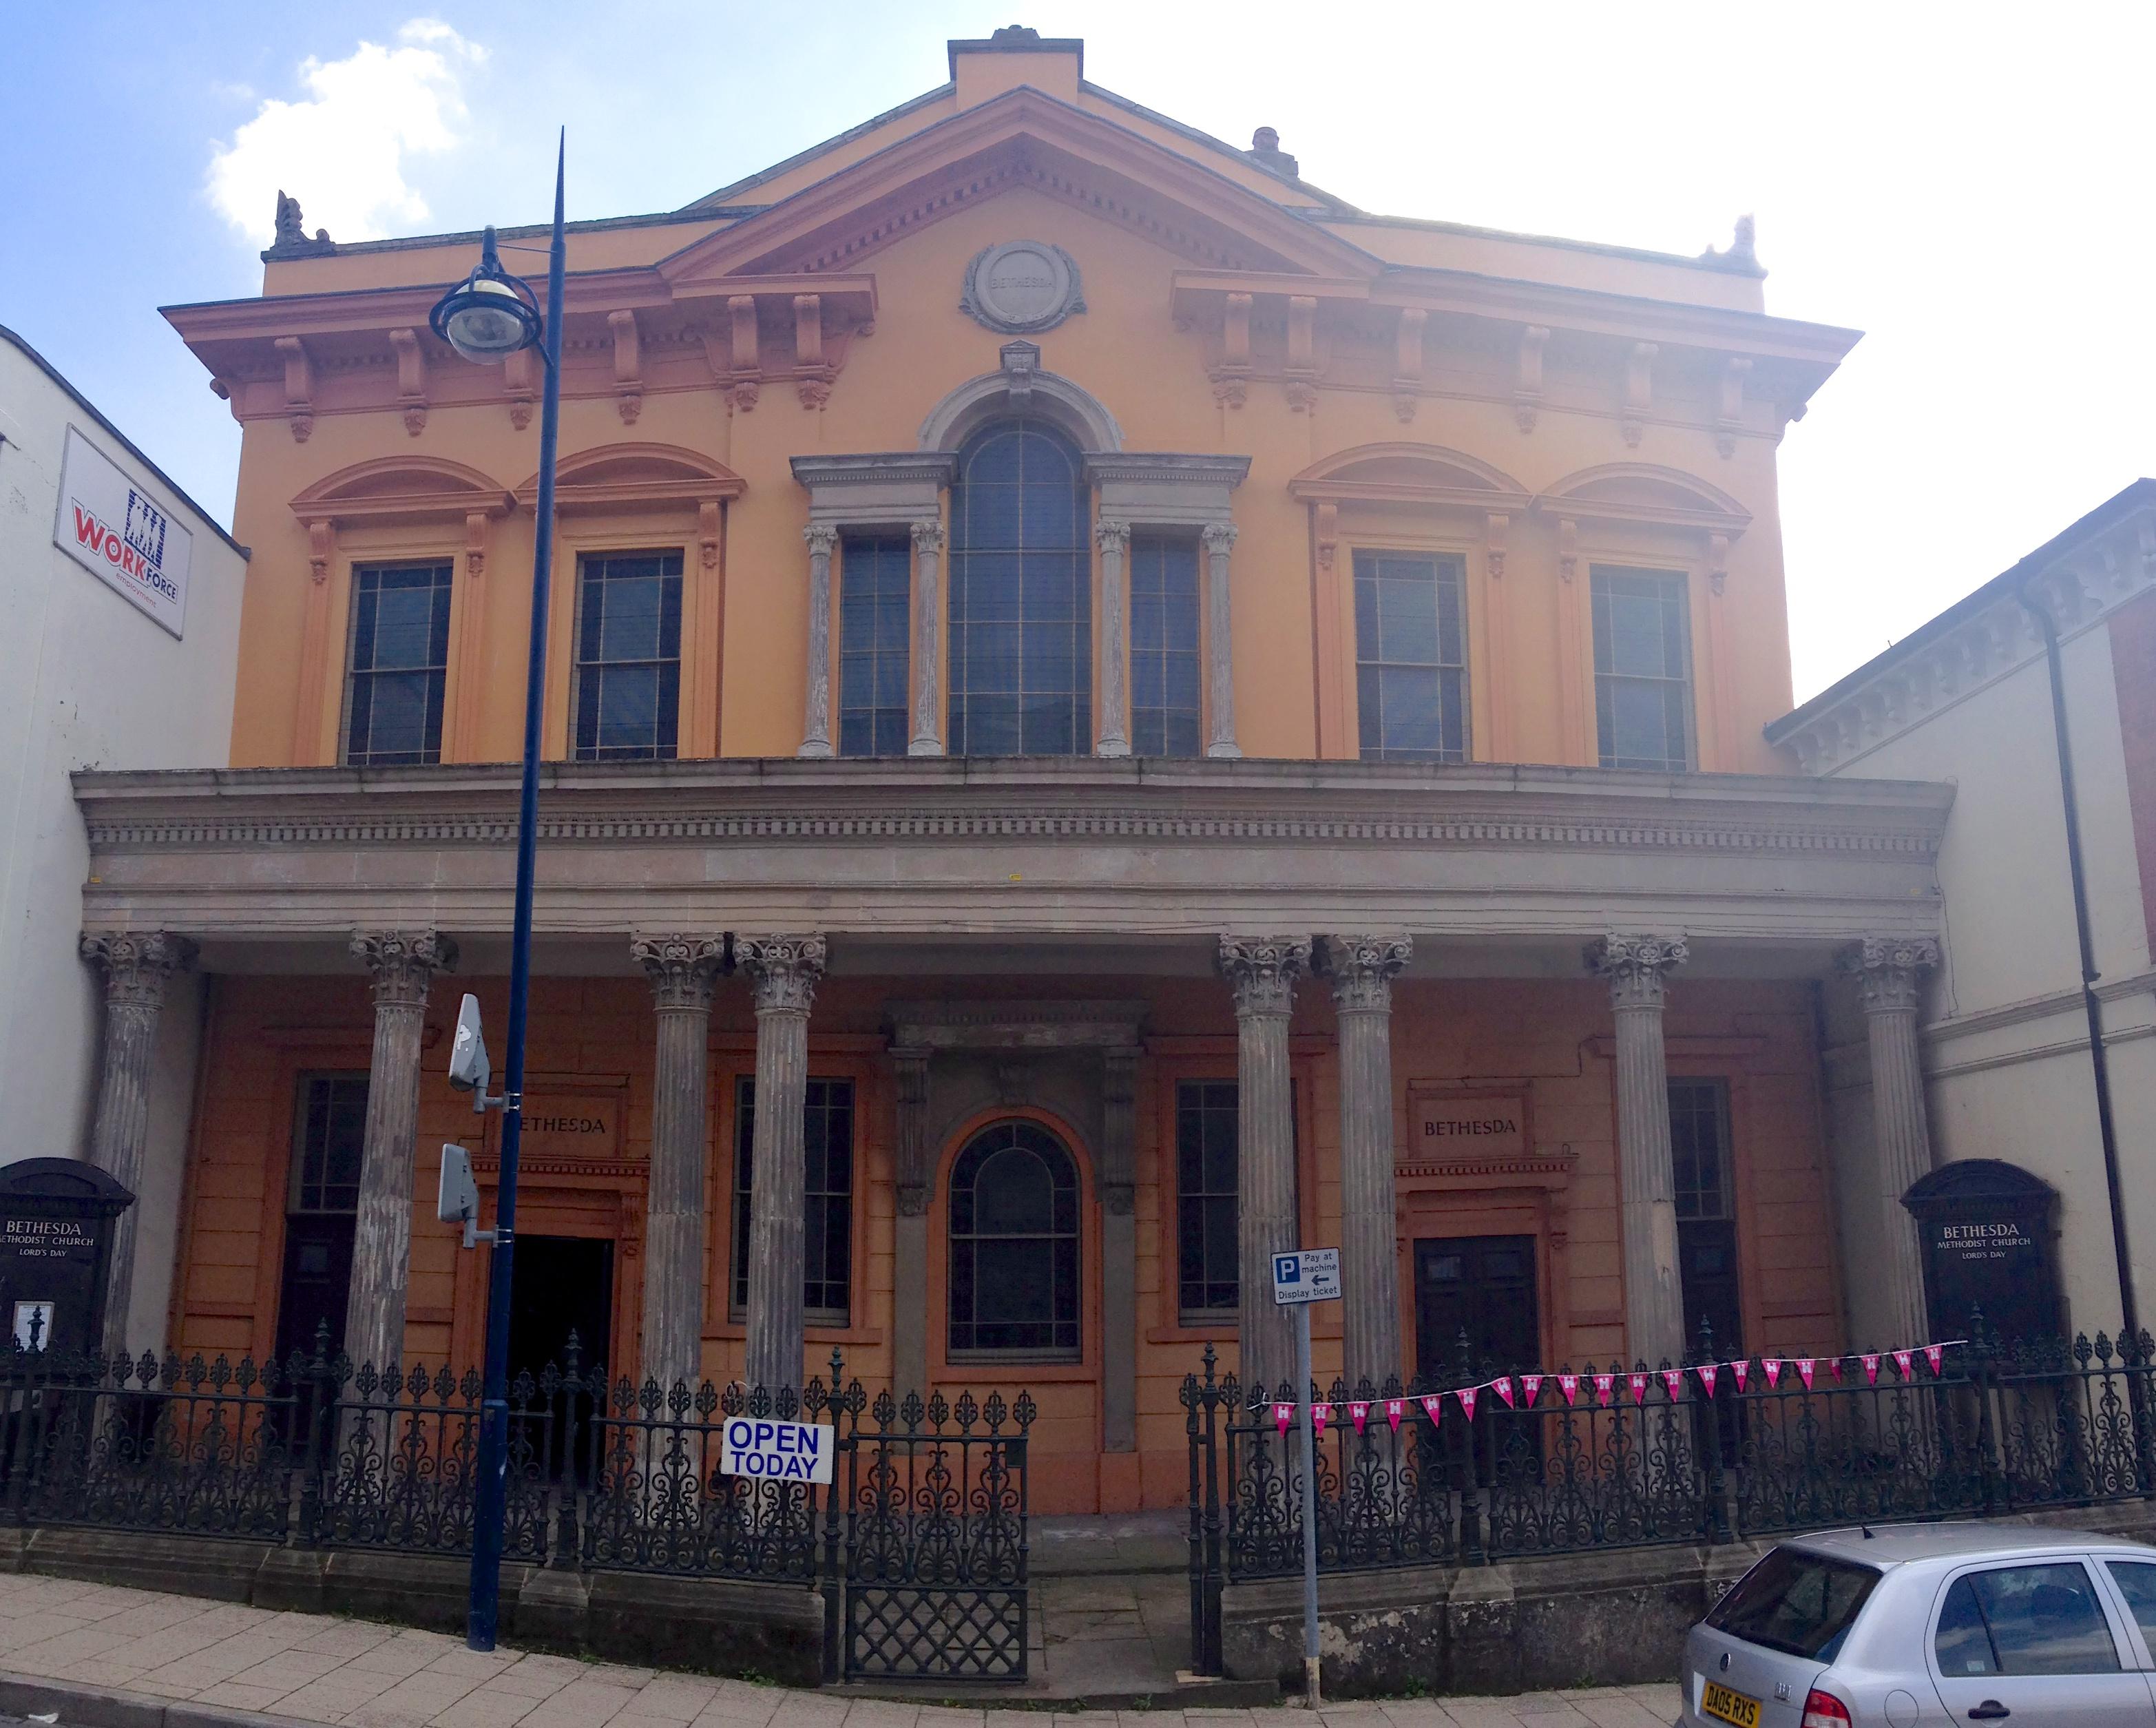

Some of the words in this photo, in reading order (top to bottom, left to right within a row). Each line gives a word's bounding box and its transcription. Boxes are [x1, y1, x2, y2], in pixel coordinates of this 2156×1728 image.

[991, 277, 1057, 289] BETHESDA
[116, 572, 157, 608] employment
[520, 1117, 605, 1134] ETHESDA
[1425, 1119, 1516, 1136] BETHESDA
[6, 1220, 81, 1235] BETHESDA
[1944, 1224, 2019, 1238] BETHESDA
[52, 1237, 94, 1246] CHURCH
[1938, 1239, 1987, 1249] METHODIST
[1992, 1238, 2031, 1247] CHURCH
[1304, 1254, 1320, 1262] Pay
[1962, 1251, 1987, 1260] LORD'S
[1281, 1260, 1295, 1280] P
[1301, 1264, 1337, 1273] machine
[1279, 1289, 1310, 1300] Display
[1313, 1286, 1337, 1295] ticket
[729, 1421, 818, 1455] OPEN
[730, 1451, 818, 1479] TODAY
[1706, 1685, 1732, 1714] DA05
[1732, 1696, 1755, 1725] RXS
